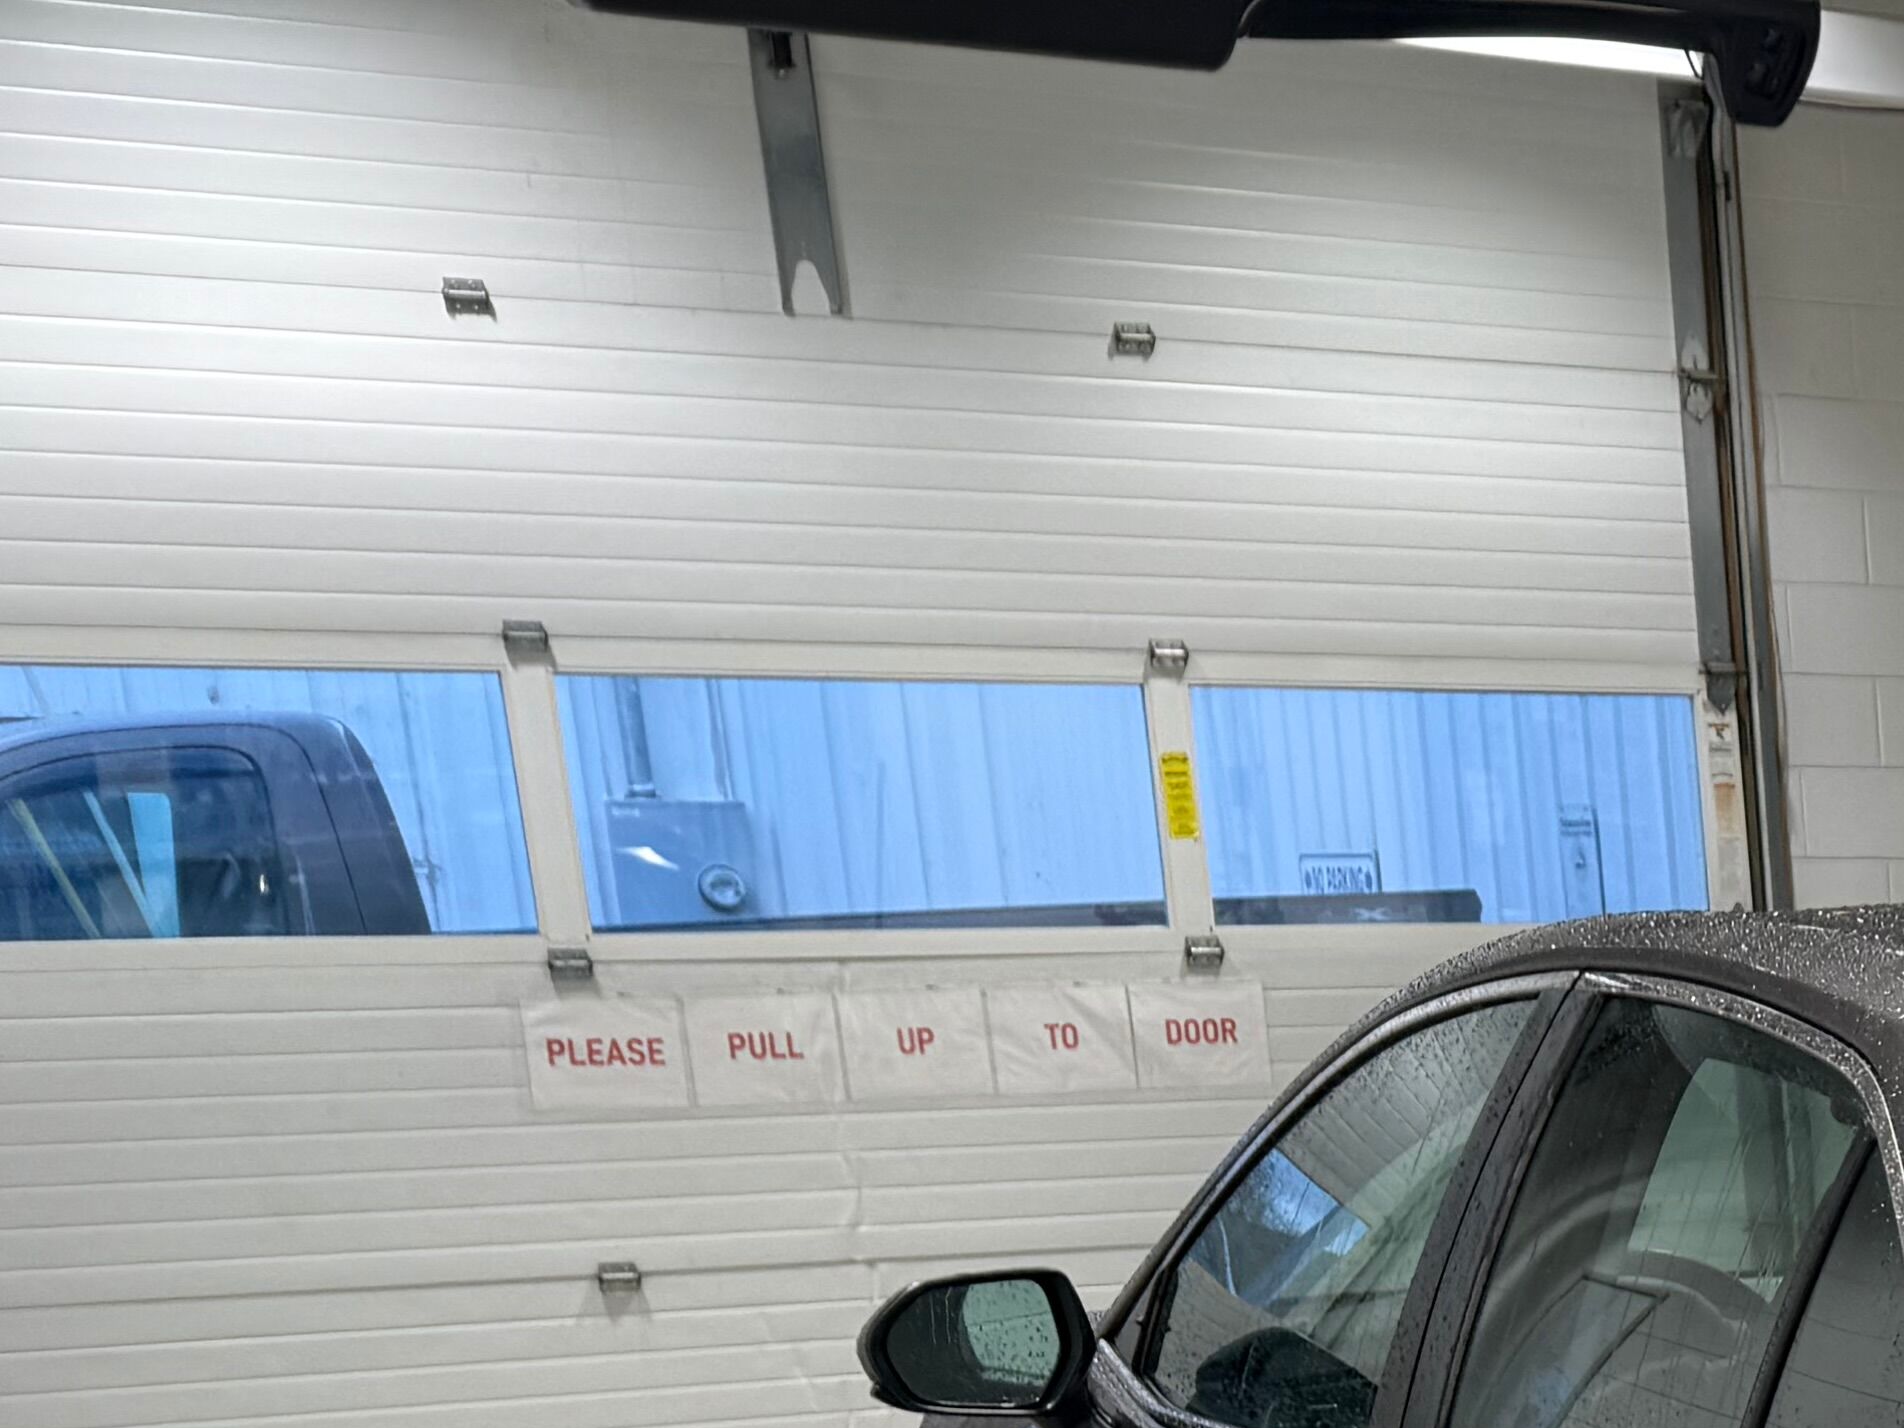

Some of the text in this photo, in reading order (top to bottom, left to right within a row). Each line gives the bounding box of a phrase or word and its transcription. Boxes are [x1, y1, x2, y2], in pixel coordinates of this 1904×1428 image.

[545, 1018, 1238, 1067] PLEASE PULL UP TO DOOR
